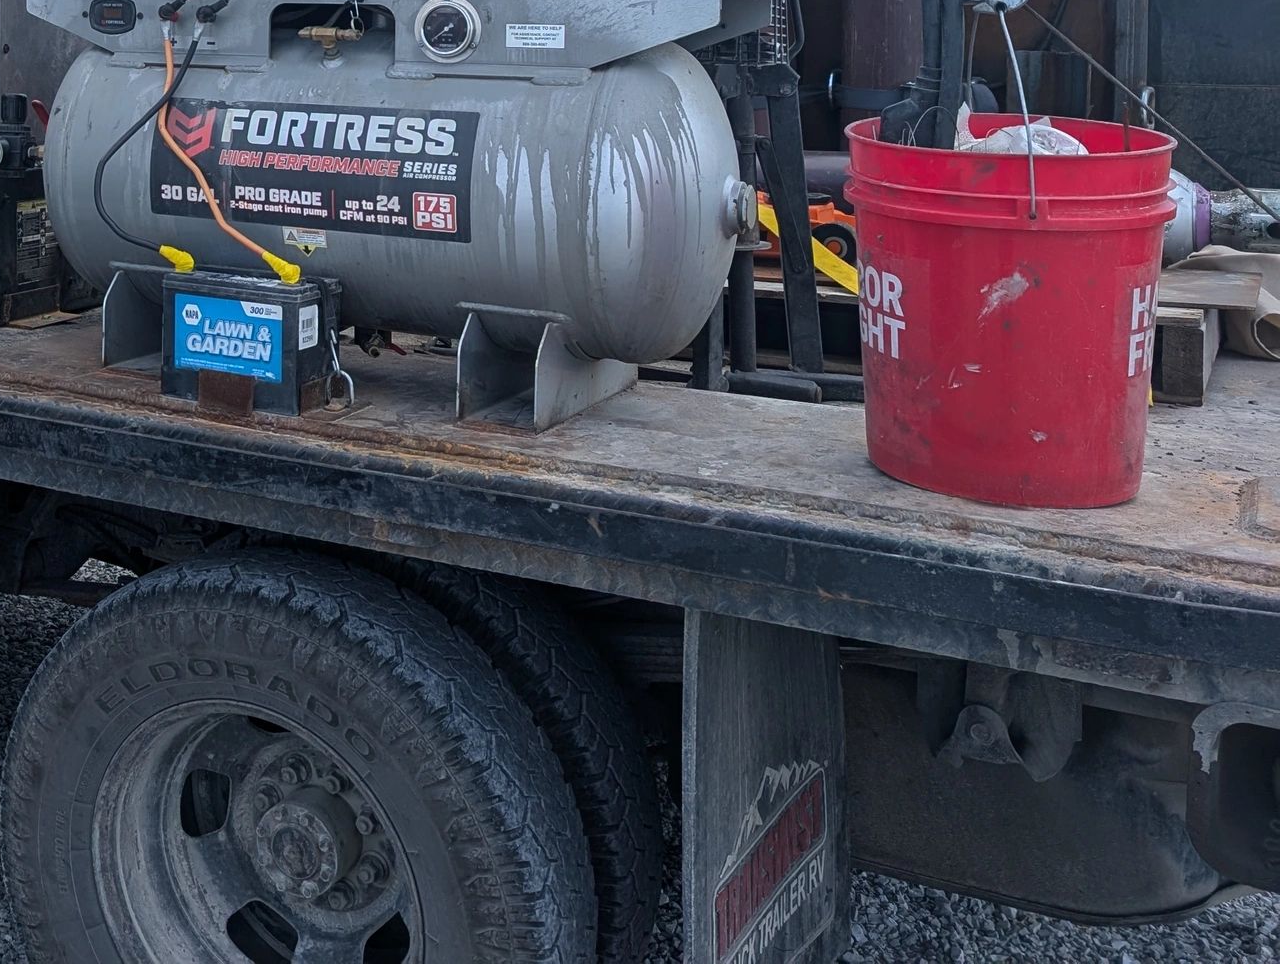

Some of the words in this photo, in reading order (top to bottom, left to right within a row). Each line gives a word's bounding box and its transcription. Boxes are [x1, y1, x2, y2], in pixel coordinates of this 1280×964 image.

[221, 108, 457, 156] FORTRESS
[219, 149, 262, 168] HIGH
[263, 151, 402, 178] PERFORMANCE
[403, 161, 458, 175] SERIES
[161, 184, 183, 200] 30
[235, 185, 266, 201] PRO
[269, 188, 323, 206] GRADE
[230, 200, 263, 212] 2-Stage
[264, 203, 283, 213] cast
[284, 205, 302, 215] iron
[303, 207, 328, 218] pump
[345, 199, 359, 211] up
[361, 199, 373, 210] to
[376, 195, 401, 212] 24
[418, 196, 451, 213] 175
[340, 210, 363, 221] CFM
[365, 214, 376, 223] at
[377, 214, 390, 224] 90
[392, 216, 407, 225] PSI
[417, 212, 453, 229] PSI
[185, 309, 199, 320] NAPA
[249, 306, 264, 315] 300
[203, 317, 253, 340] LAWN
[257, 325, 271, 342] &
[186, 333, 272, 362] GARDEN
[95, 658, 376, 762] ELDORADO
[759, 870, 809, 954] TRAILER
[808, 850, 826, 893] RV
